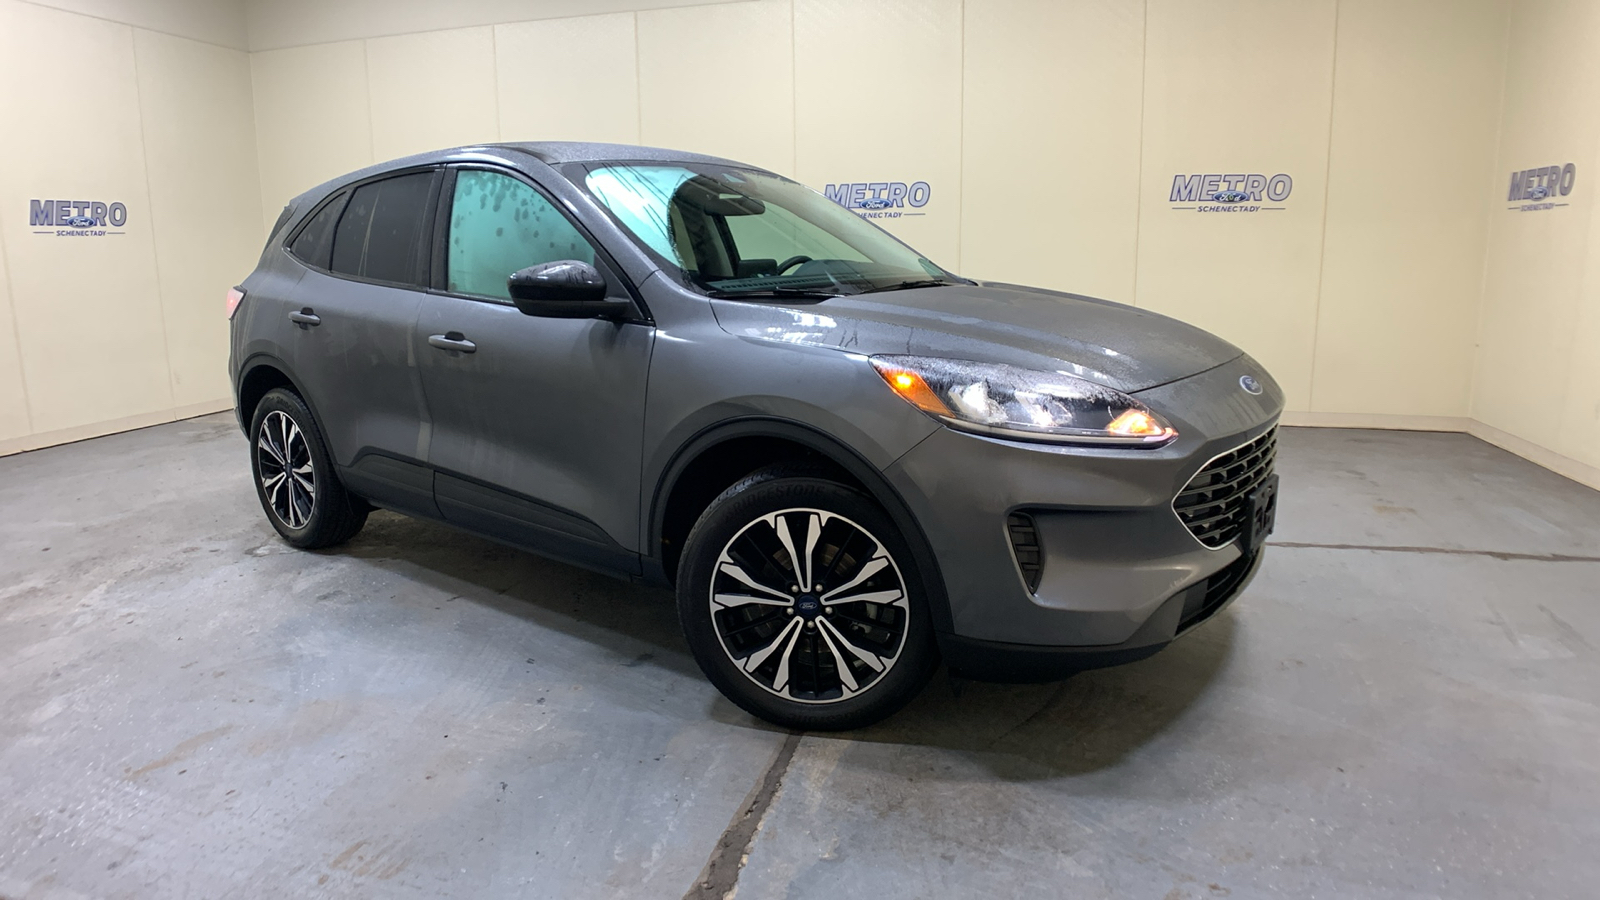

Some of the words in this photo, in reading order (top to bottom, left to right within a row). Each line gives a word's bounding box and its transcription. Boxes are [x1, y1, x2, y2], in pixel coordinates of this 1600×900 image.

[1169, 173, 1293, 202] METRO
[1507, 163, 1576, 202] METRO
[824, 181, 931, 208] METRO
[865, 200, 888, 209] Ford
[1197, 205, 1261, 213] SCHENECTADY
[29, 199, 127, 227] METRO
[857, 211, 903, 219] HENECTADY
[71, 217, 92, 227] Ford
[56, 229, 107, 237] SCHENECTADY
